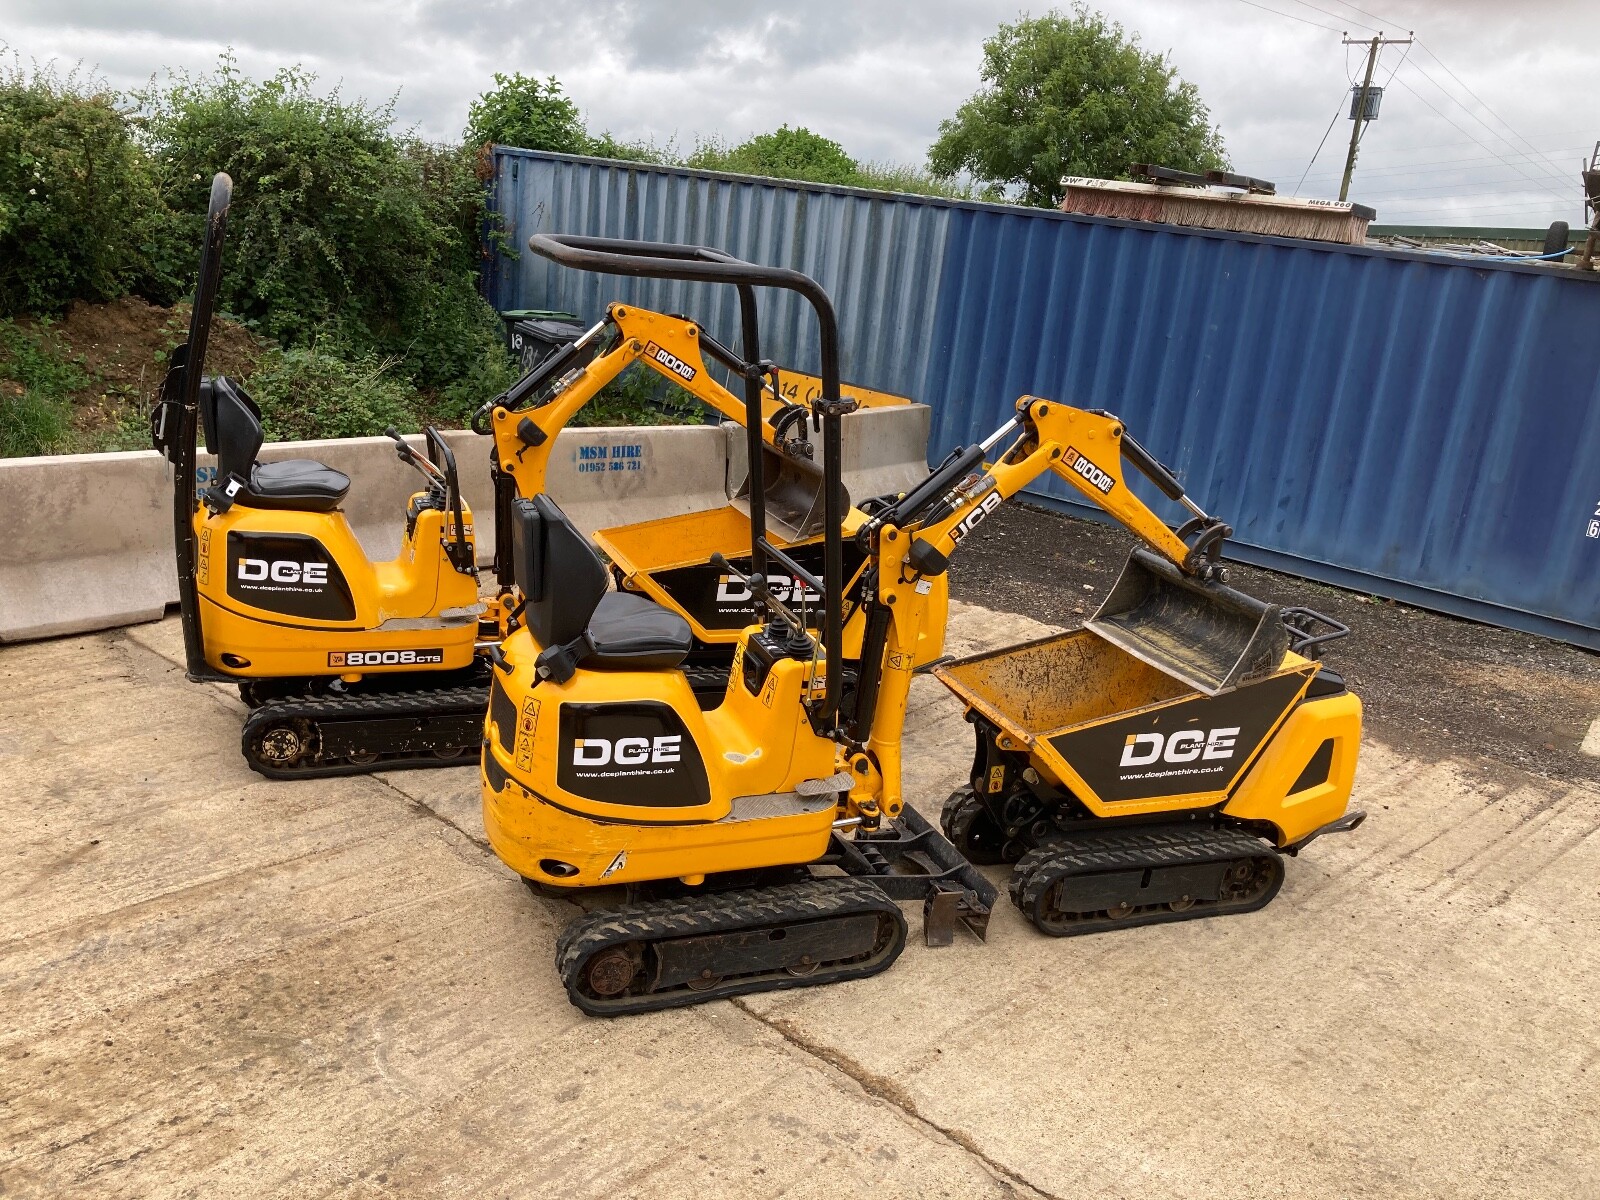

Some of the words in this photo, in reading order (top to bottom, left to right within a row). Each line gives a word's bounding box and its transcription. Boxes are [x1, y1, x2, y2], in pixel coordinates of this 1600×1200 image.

[579, 446, 608, 460] MSM
[611, 445, 642, 458] HIRE
[578, 462, 606, 472] 01952
[627, 461, 641, 470] 721
[954, 492, 1003, 543] JCB
[238, 558, 328, 584] DCE
[573, 735, 681, 766] DCE
[1119, 727, 1240, 767] DCE
[1180, 742, 1205, 750] PLANT
[576, 767, 675, 778] www.dceplanthire.co.uk
[1120, 766, 1224, 781] www.dceplanthire.co.uk
